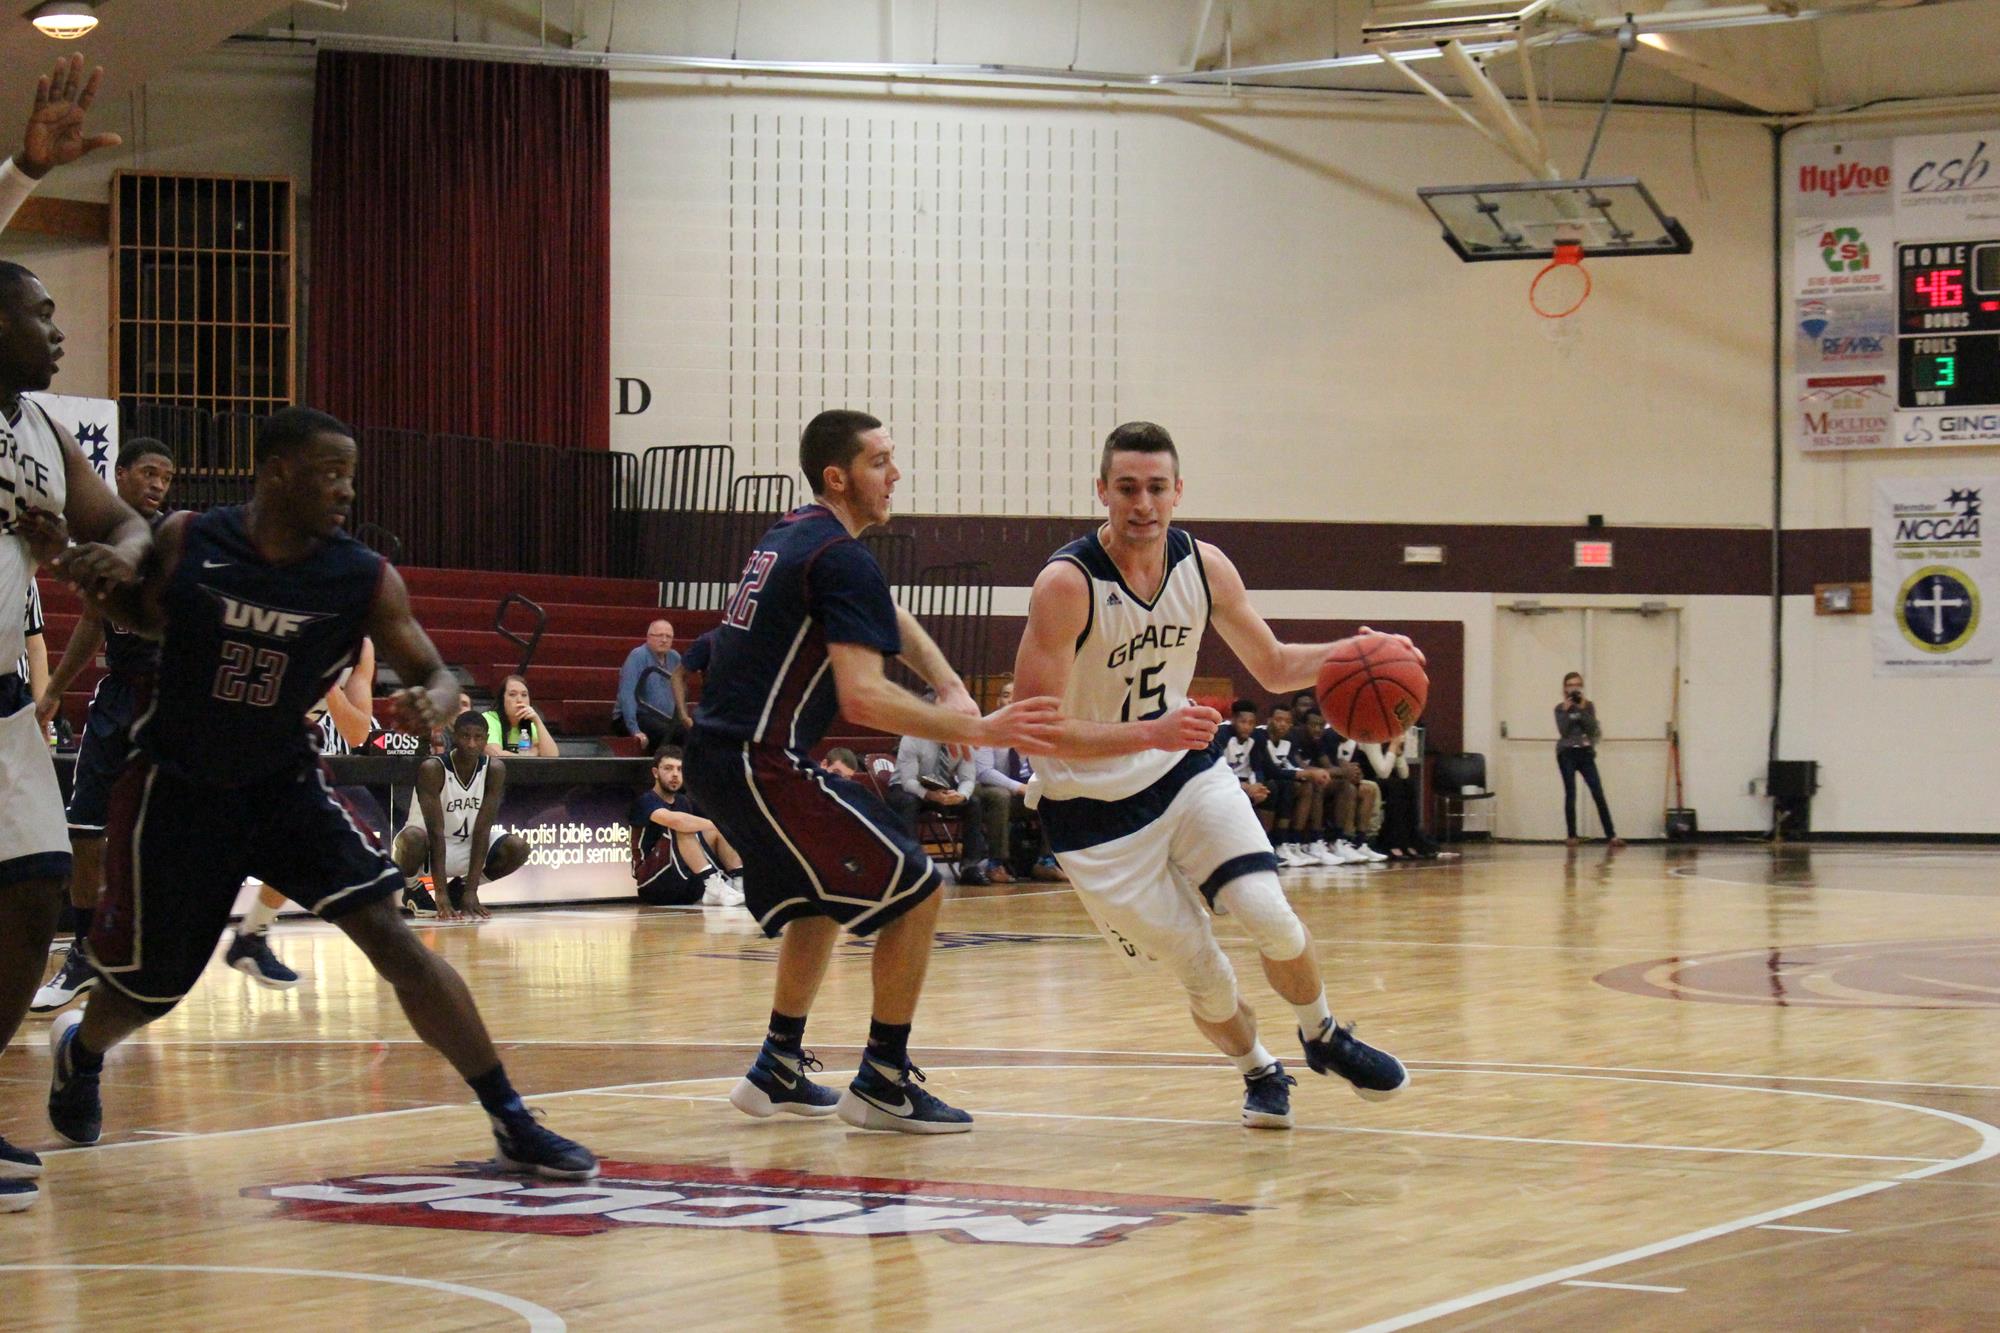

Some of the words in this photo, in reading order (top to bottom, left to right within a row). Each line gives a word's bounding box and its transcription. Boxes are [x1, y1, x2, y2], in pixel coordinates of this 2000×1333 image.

[1908, 141, 1990, 193] csb
[1903, 246, 1966, 267] HOME
[1915, 269, 1963, 308] 46
[1924, 312, 1970, 329] BONUS
[1913, 338, 1957, 355] FOULS
[1935, 356, 1955, 386] 3
[615, 377, 652, 415] D
[1940, 415, 2000, 432] GING
[1896, 518, 1980, 541] NCCAA
[220, 596, 316, 638] UVF
[1107, 624, 1193, 669] GRACE
[211, 640, 290, 707] 23
[1120, 660, 1168, 723] 15
[384, 732, 420, 750] POSS
[452, 817, 470, 842] 4
[560, 822, 592, 844] bible
[595, 821, 631, 846] colle
